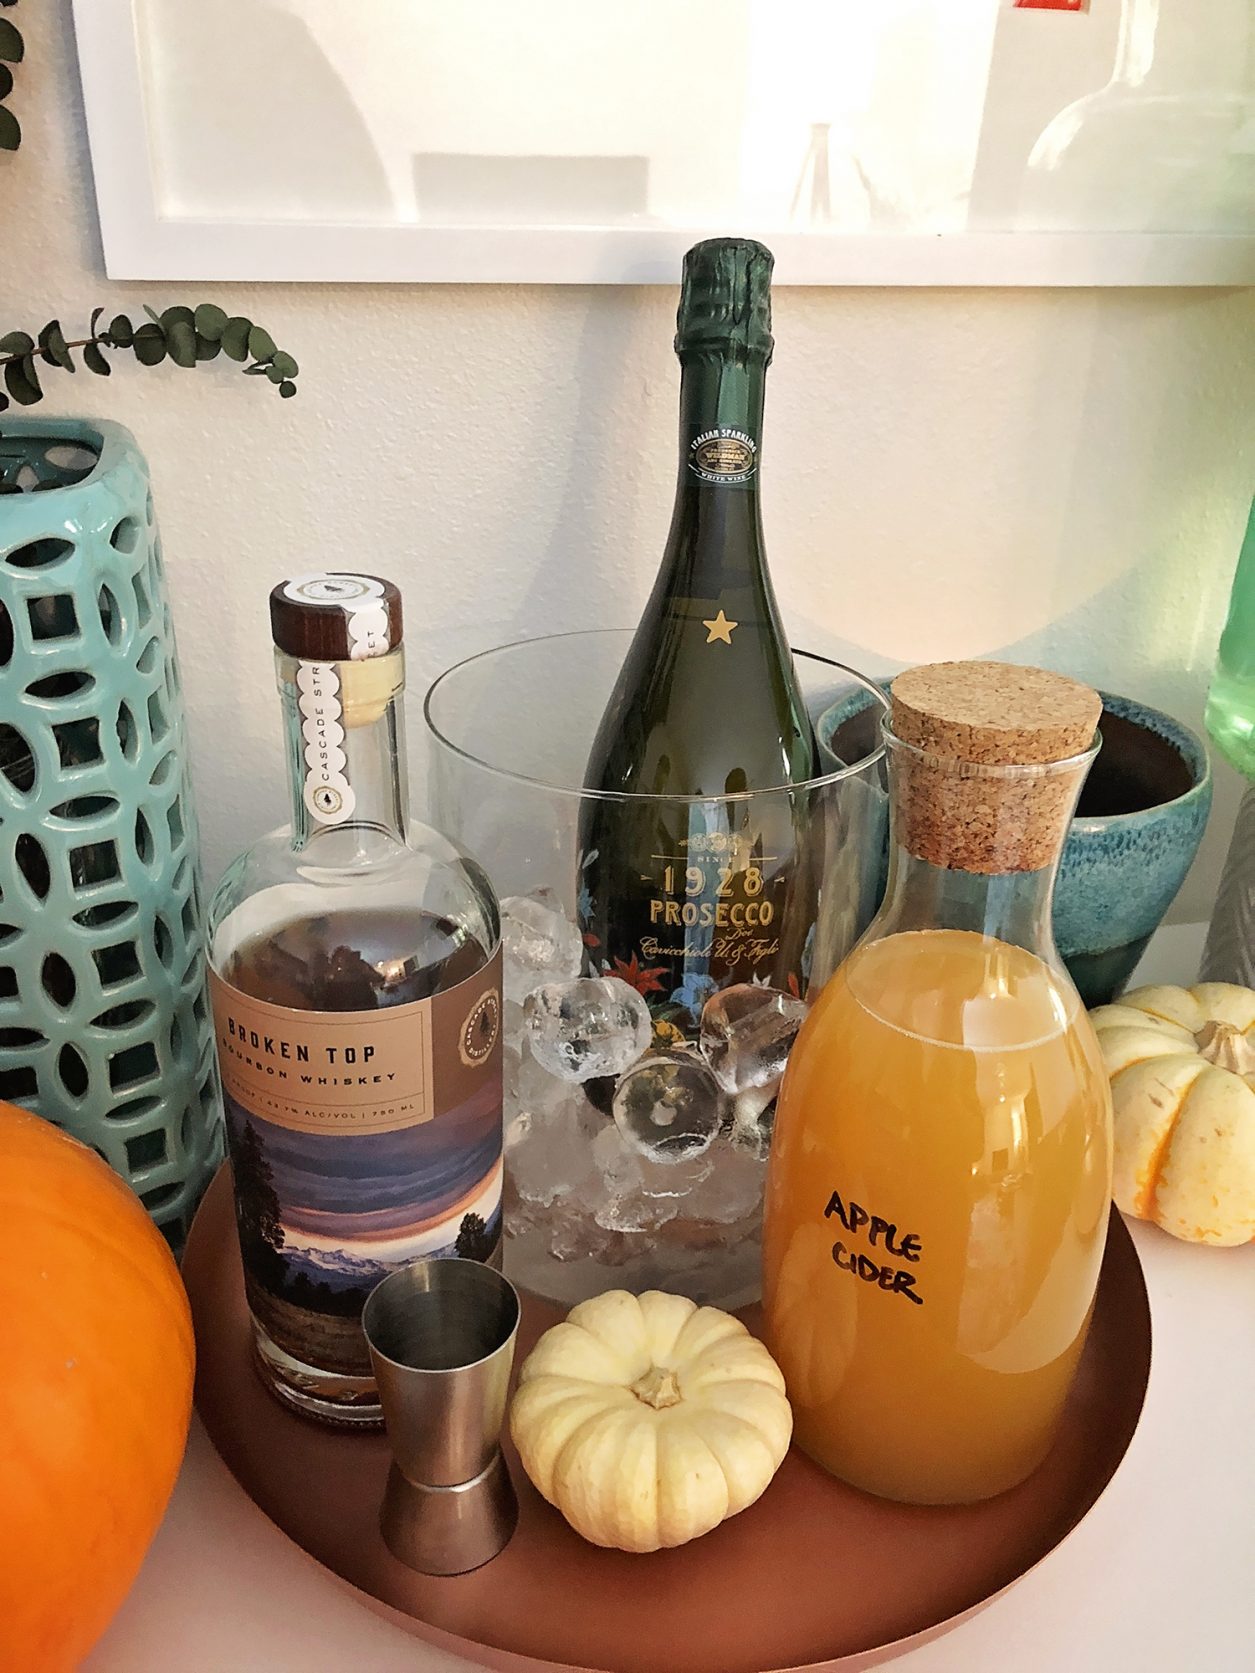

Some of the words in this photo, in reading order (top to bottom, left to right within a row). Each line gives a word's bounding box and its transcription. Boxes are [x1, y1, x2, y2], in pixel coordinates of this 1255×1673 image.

[690, 429, 720, 450] ITALIAN
[721, 428, 757, 453] SPARKLING
[701, 472, 725, 481] WHITE
[315, 708, 329, 781] CASCADE
[664, 865, 764, 897] 1928
[650, 899, 775, 927] PROSECCO
[227, 1016, 309, 1062] BROKEN
[326, 1046, 375, 1064] TOP
[300, 1073, 396, 1086] WHISKEY
[401, 1103, 415, 1111] ML
[824, 1190, 922, 1262] APPLE
[832, 1241, 924, 1305] CIDER
